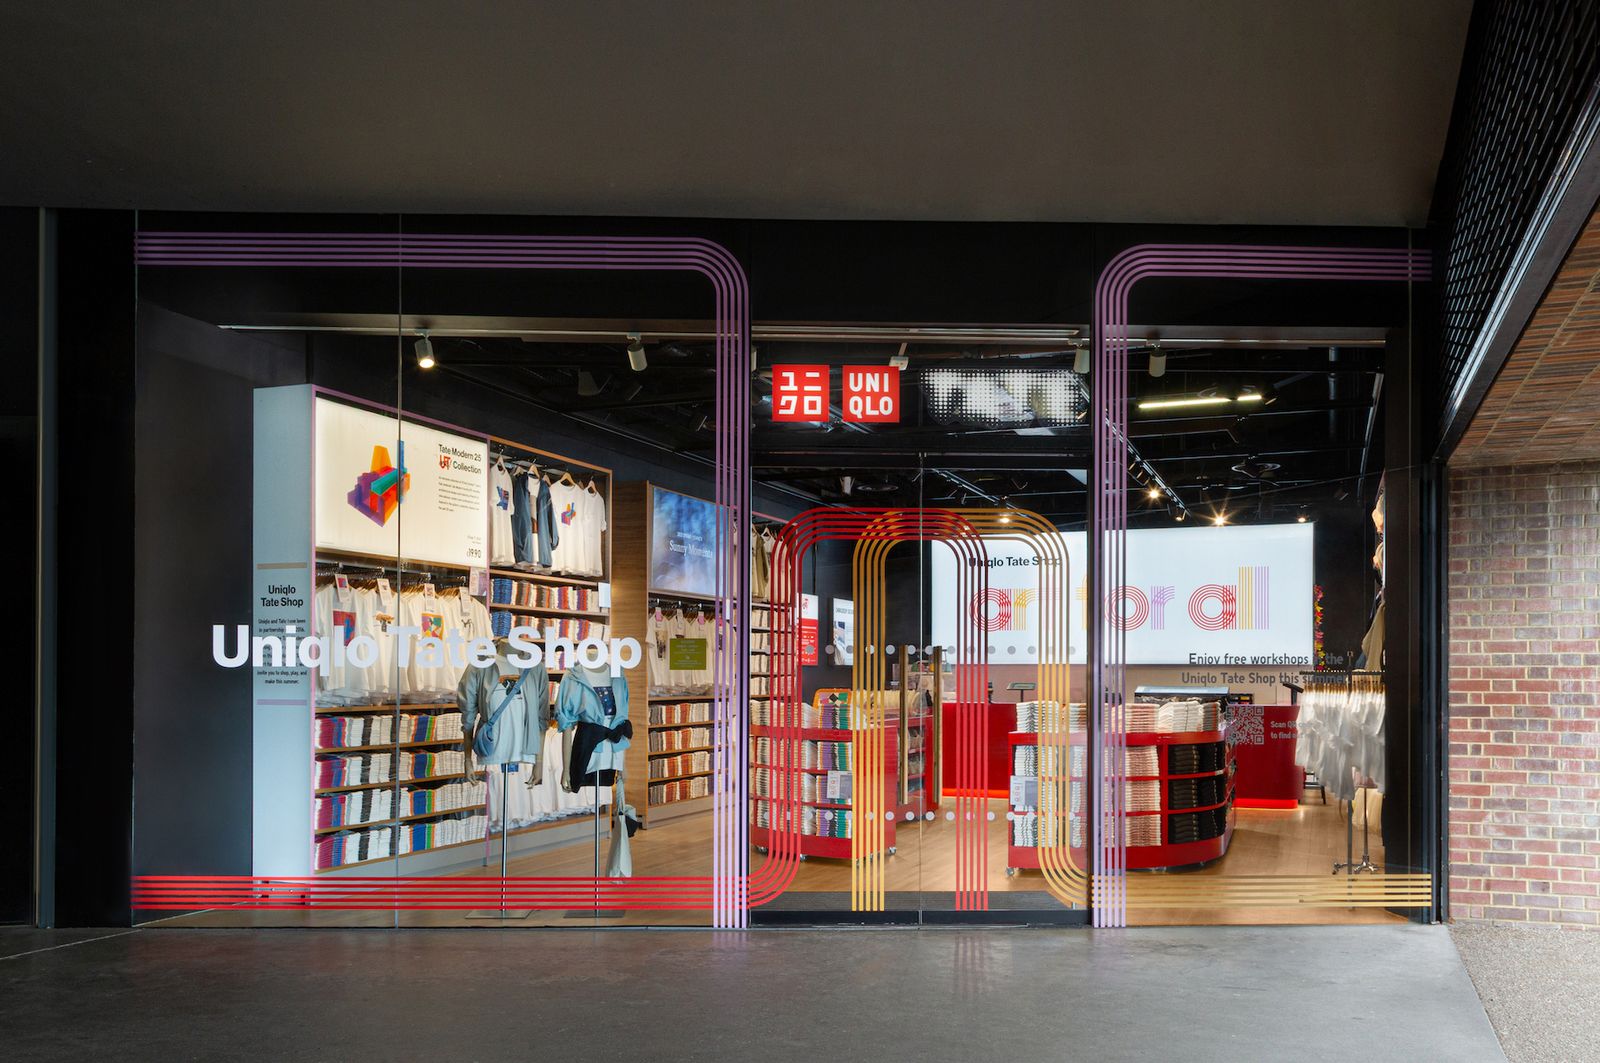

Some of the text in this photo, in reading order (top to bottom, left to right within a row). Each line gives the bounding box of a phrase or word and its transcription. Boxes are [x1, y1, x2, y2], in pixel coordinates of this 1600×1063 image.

[849, 372, 889, 392] UNI
[849, 395, 893, 419] QLO
[438, 443, 482, 462] Tate Modern 25
[452, 460, 482, 474] Collection
[968, 557, 1004, 569] Unqlo
[1006, 556, 1030, 566] Tate
[268, 584, 296, 596] Uniqlo
[260, 596, 304, 608] Tate Shop
[212, 624, 379, 677] Uniqlo
[388, 625, 497, 669] Tate
[506, 625, 642, 678] Shop
[1189, 652, 1221, 668] Enjoy
[1223, 652, 1247, 665] free
[1250, 652, 1309, 669] workshops
[1325, 653, 1344, 665] the
[1181, 672, 1218, 688] Uniqlo
[1221, 672, 1246, 684] Tate
[1249, 671, 1276, 687] Shop
[1279, 671, 1300, 684] this
[1270, 720, 1286, 728] Scan
